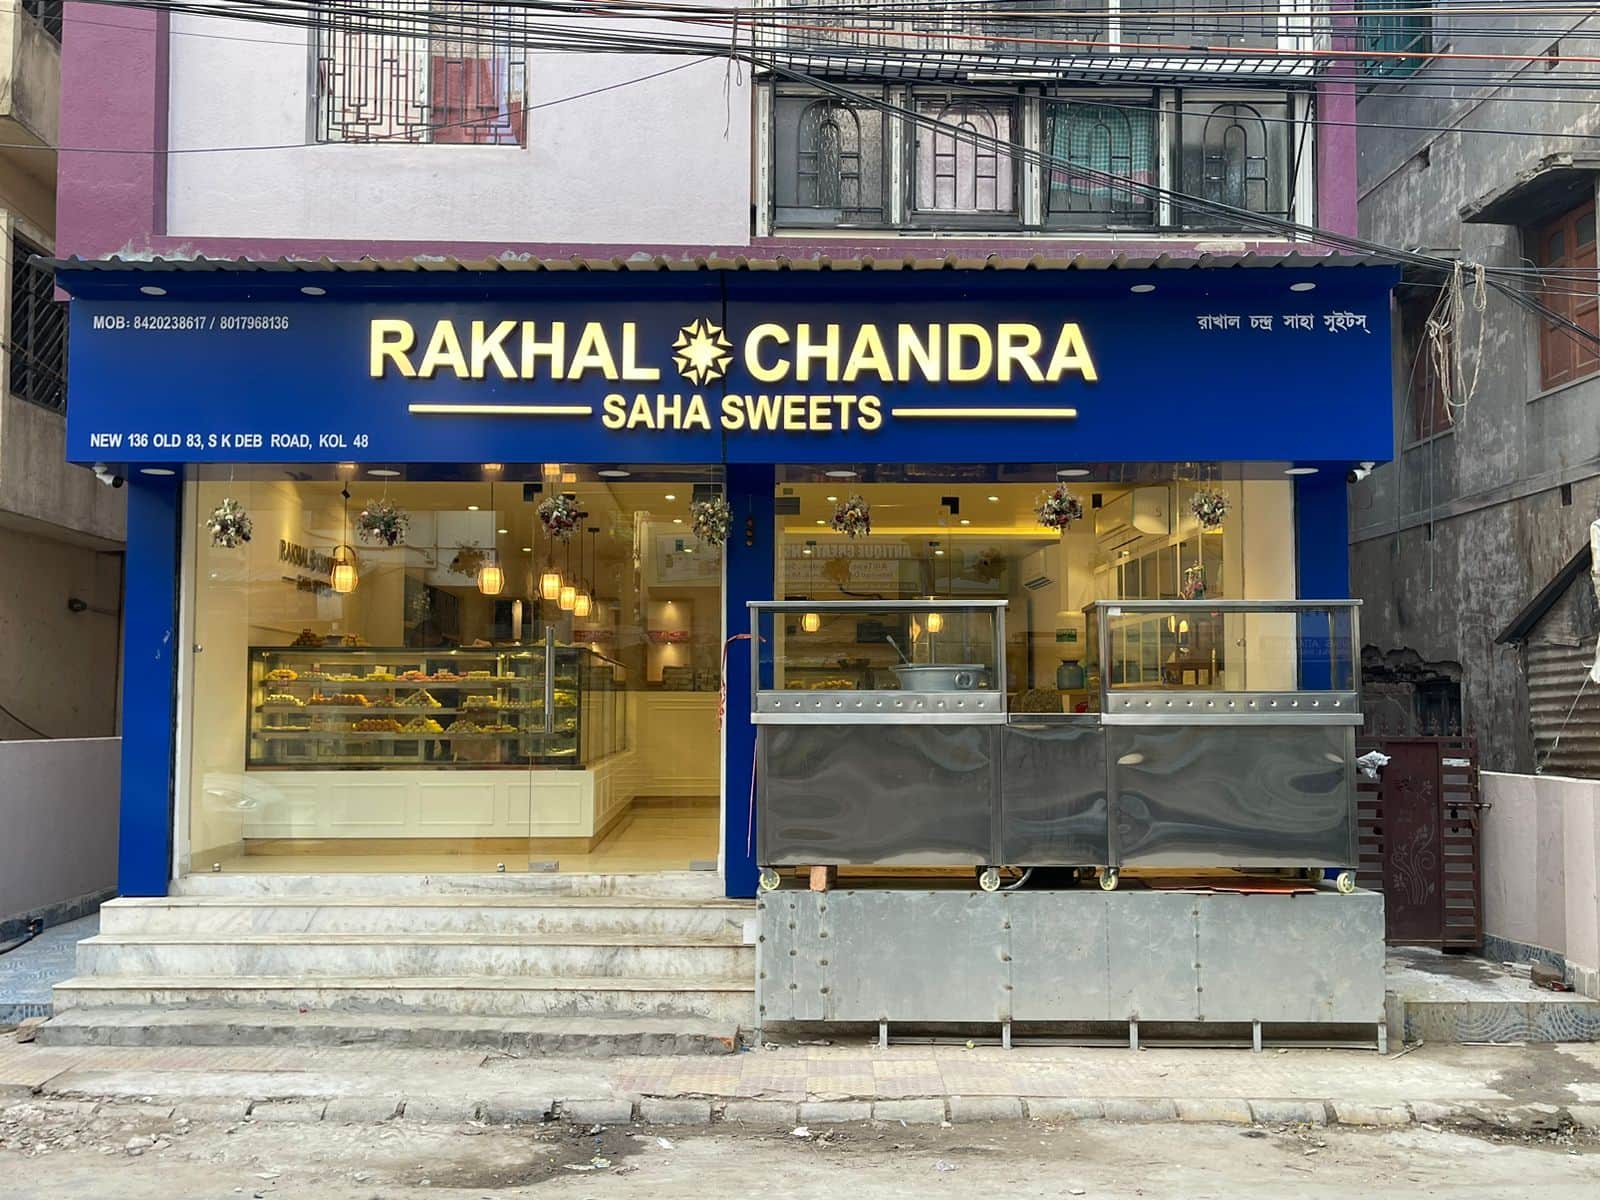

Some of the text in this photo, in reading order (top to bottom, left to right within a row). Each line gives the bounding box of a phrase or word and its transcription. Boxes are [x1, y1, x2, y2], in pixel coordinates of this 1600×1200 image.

[93, 315, 131, 330] MOB:
[133, 315, 207, 330] 8420238617
[219, 315, 289, 330] 8017968136
[1197, 313, 1241, 330] রাখাল
[1248, 314, 1273, 331] চন্দ্র
[1283, 313, 1314, 330] সাহা
[370, 319, 1098, 383] RAKHAL CHANDRA
[601, 393, 882, 431] SAHA SWEETS
[90, 433, 123, 448] NEW
[127, 433, 149, 448] 136
[152, 433, 182, 448] OLD
[234, 433, 263, 448] DEB
[270, 433, 313, 450] ROAD,
[319, 433, 348, 448] KOL
[352, 433, 369, 448] 48
